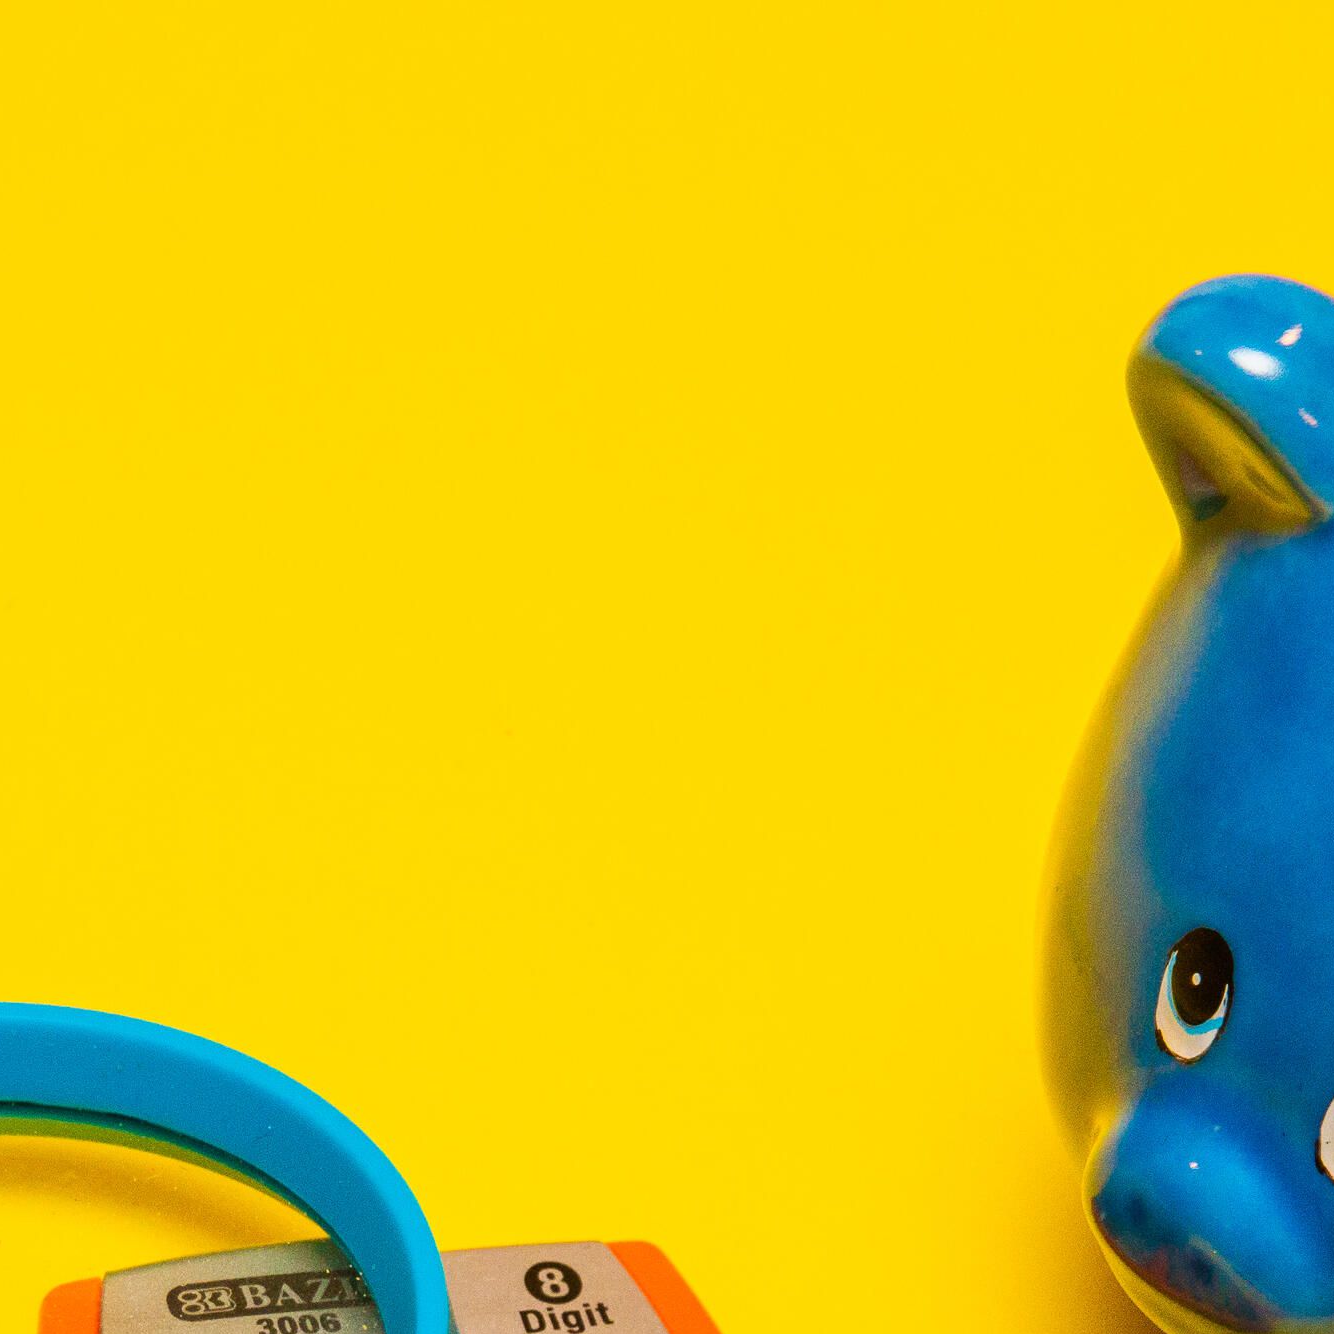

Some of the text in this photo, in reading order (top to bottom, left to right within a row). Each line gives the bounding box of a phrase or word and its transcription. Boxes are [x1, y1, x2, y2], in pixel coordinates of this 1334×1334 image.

[239, 1276, 367, 1309] BAZI
[538, 1267, 570, 1298] 8
[519, 1302, 615, 1334] Digit
